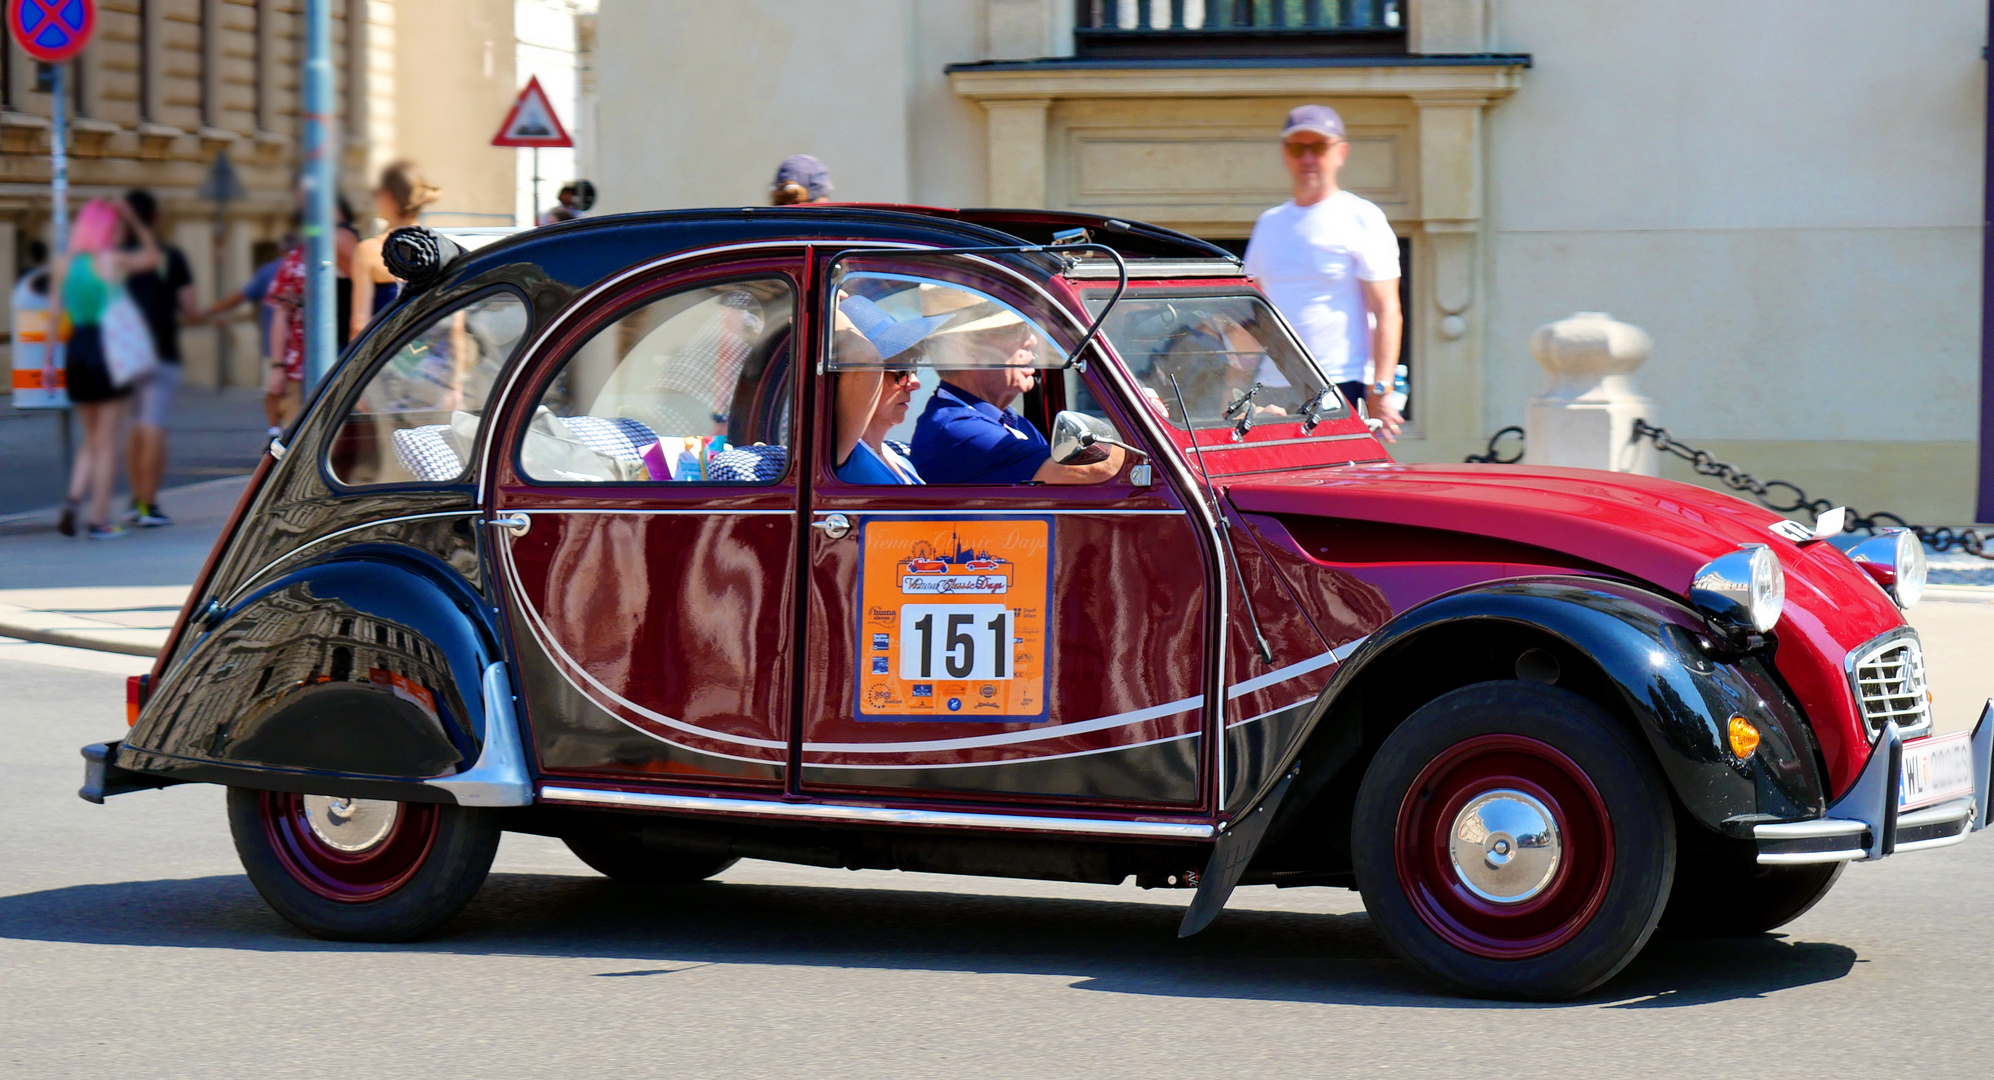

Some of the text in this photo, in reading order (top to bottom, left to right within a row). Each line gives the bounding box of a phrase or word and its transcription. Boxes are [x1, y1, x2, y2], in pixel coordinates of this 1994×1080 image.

[933, 528, 993, 550] Clssic
[1000, 524, 1046, 557] Days
[905, 575, 1005, 594] Vienna Classic Days
[873, 608, 896, 616] huma
[915, 613, 1006, 679] 151
